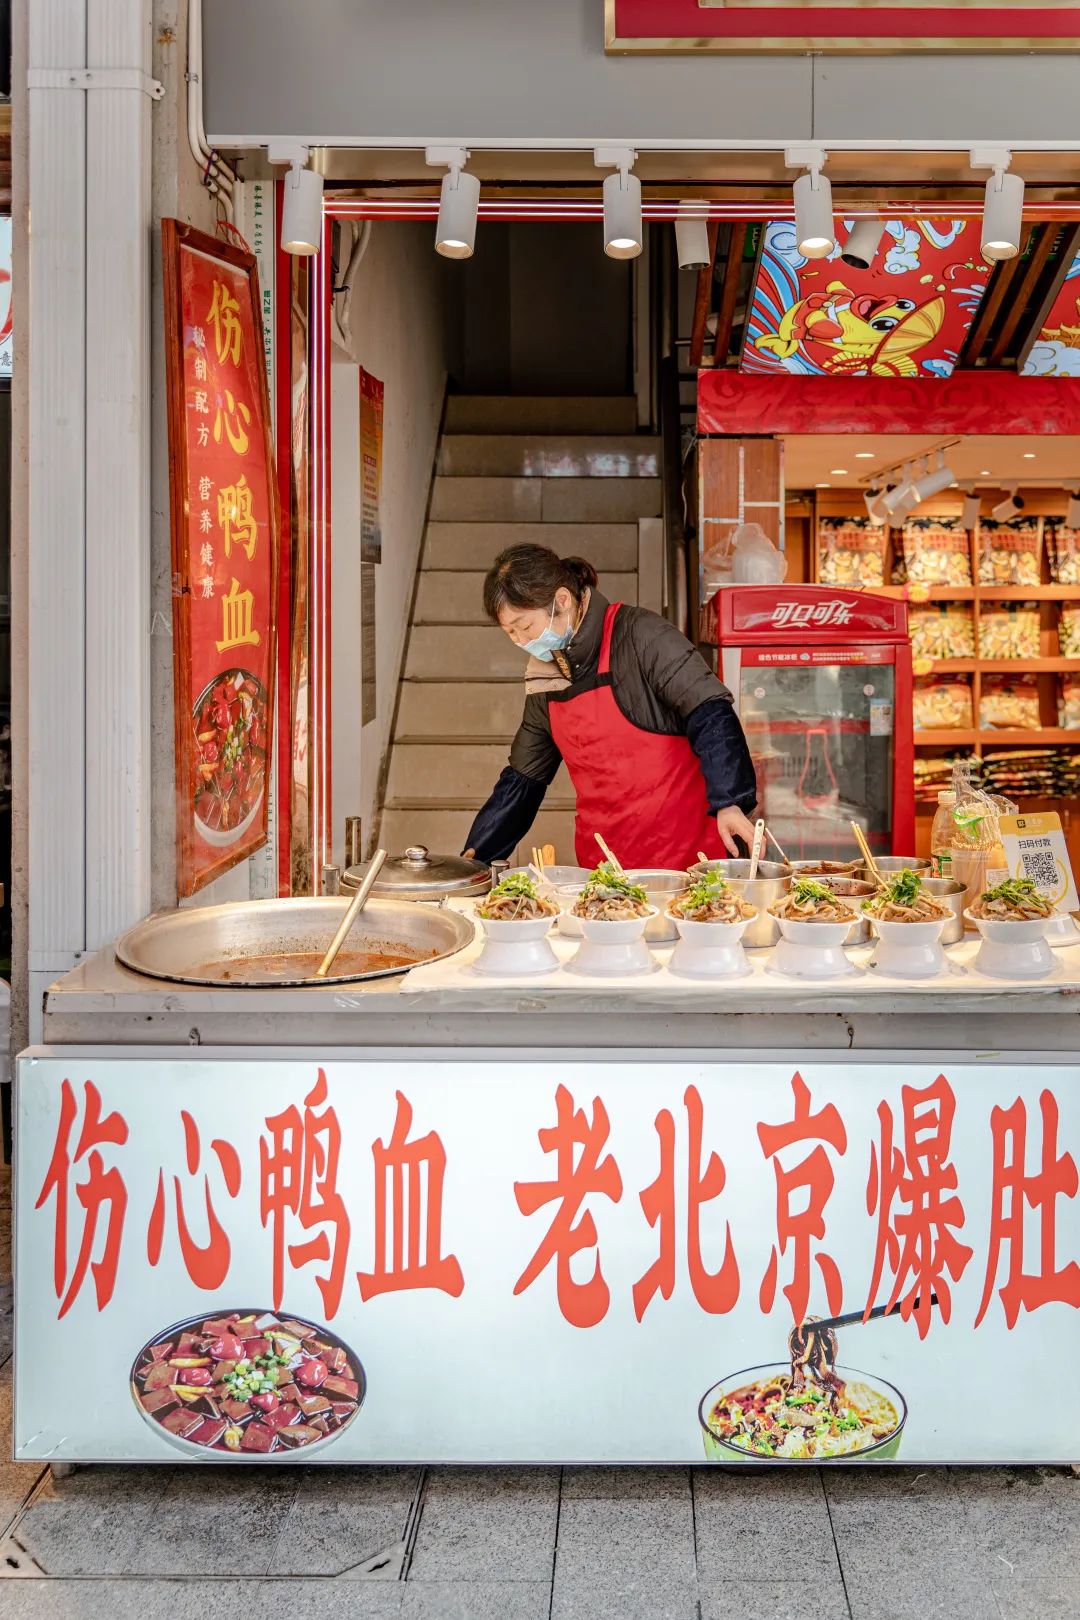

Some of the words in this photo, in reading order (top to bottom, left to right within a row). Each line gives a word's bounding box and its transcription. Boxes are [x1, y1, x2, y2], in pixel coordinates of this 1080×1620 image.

[192, 325, 210, 447] 秘制配方
[206, 280, 260, 653] 伤心鸭血
[199, 476, 215, 598] 营养健康
[770, 600, 858, 628] 可口可乐
[1018, 838, 1051, 849] 扫码付款
[35, 1068, 465, 1320] 伤心鸭血
[512, 1070, 1080, 1340] 老北京爆肚
